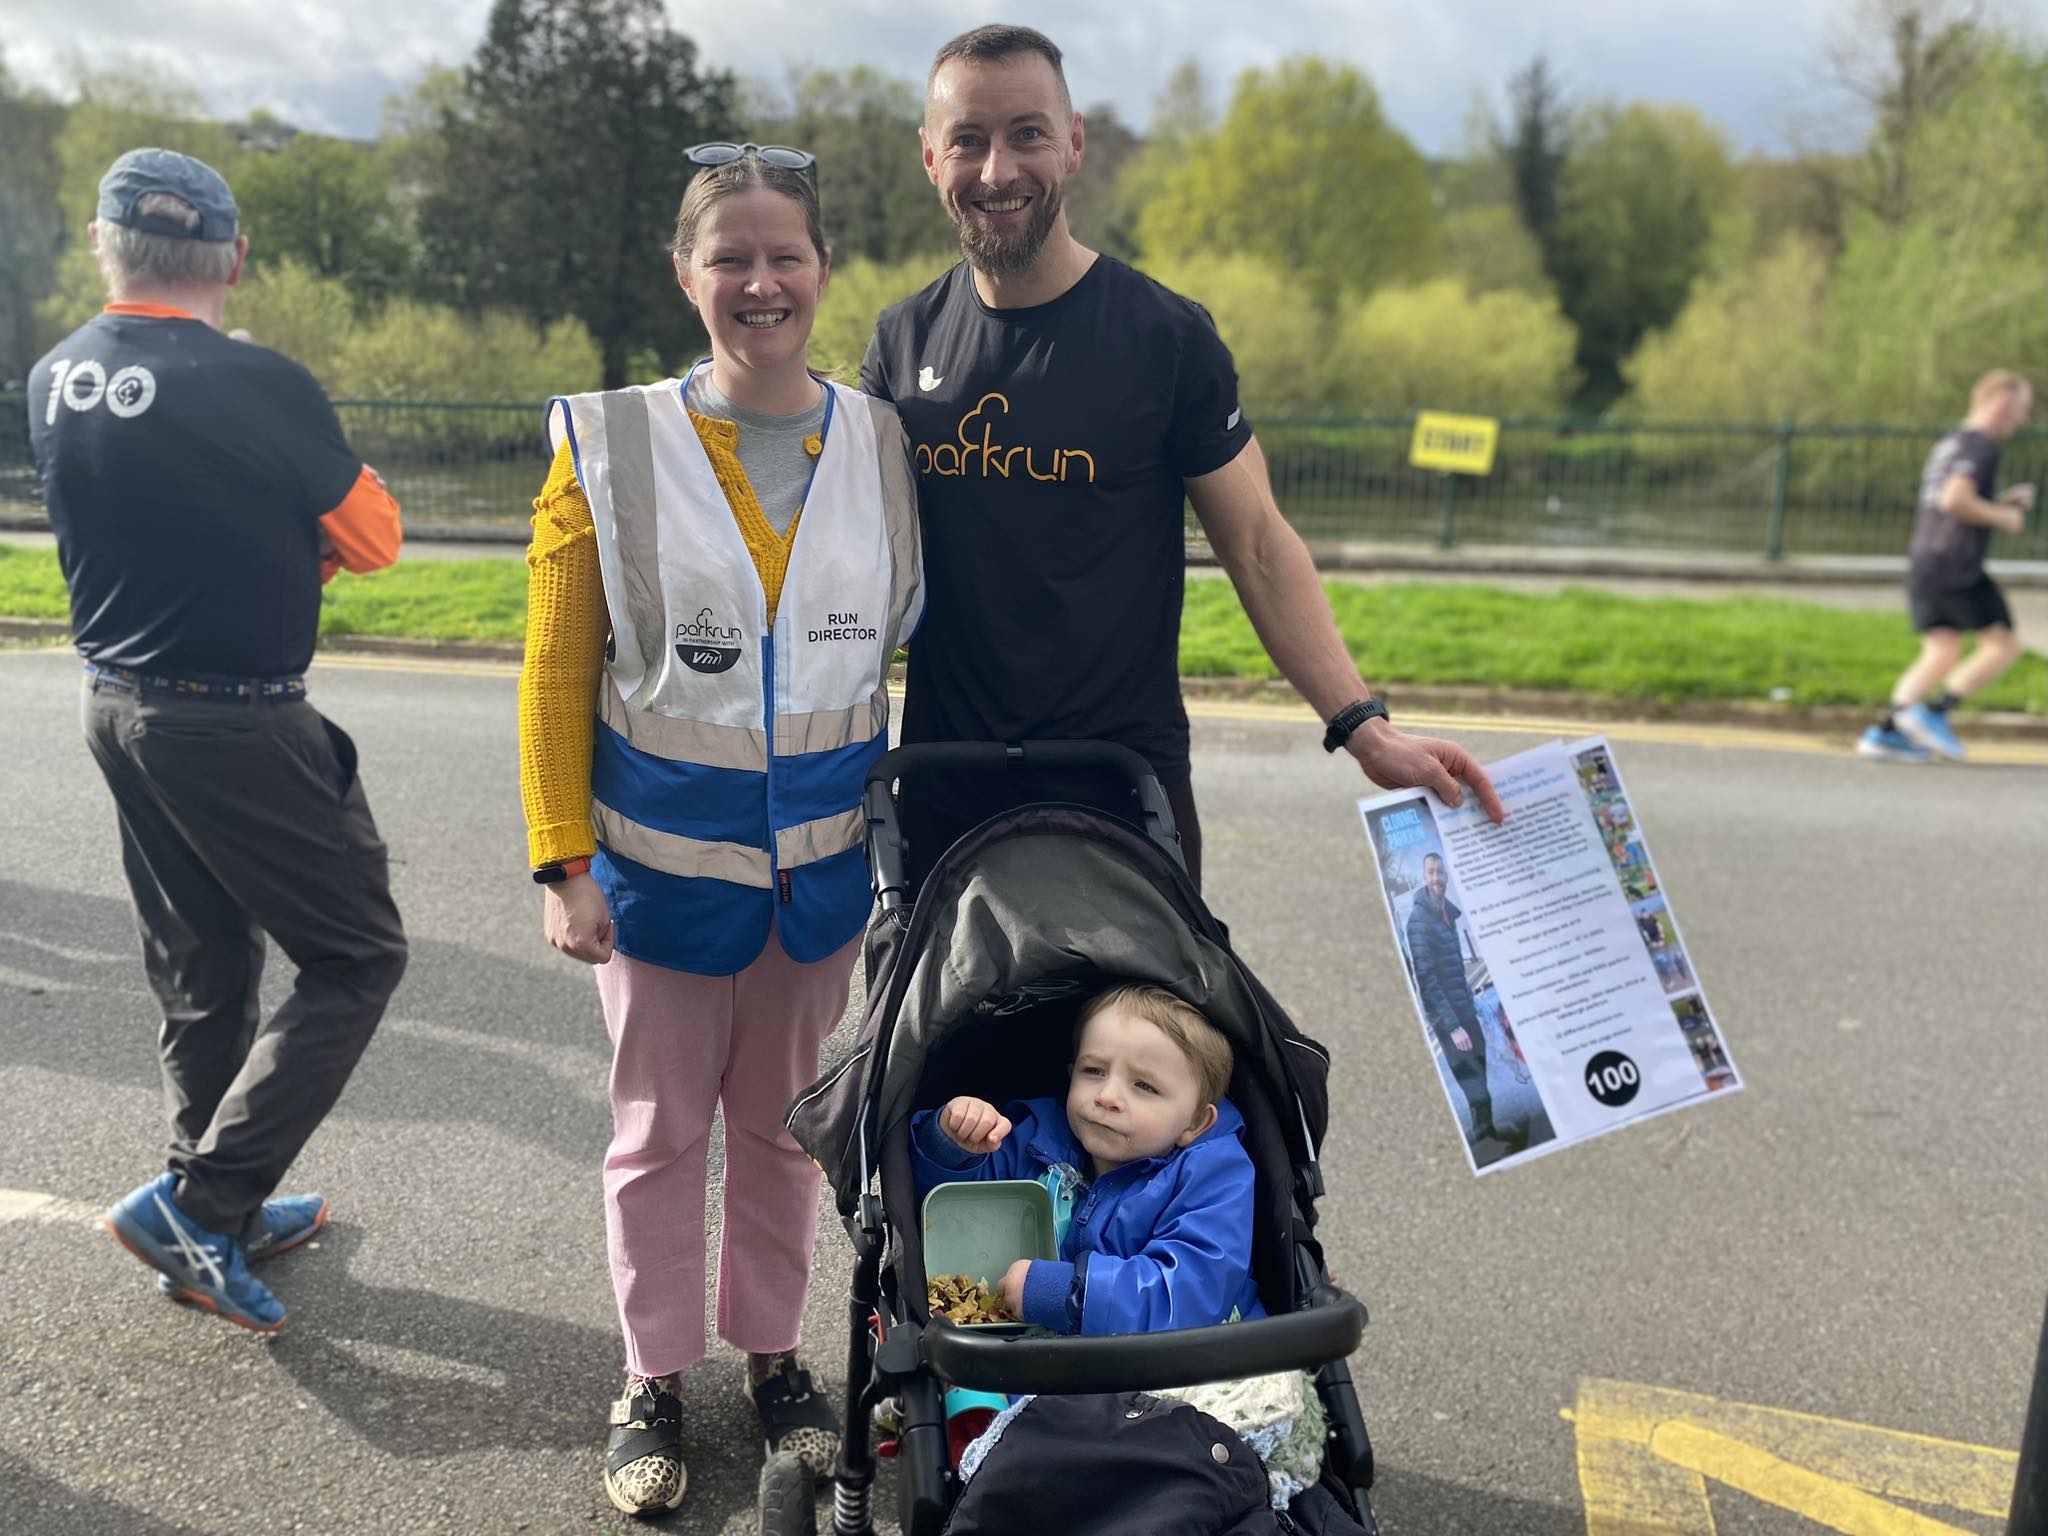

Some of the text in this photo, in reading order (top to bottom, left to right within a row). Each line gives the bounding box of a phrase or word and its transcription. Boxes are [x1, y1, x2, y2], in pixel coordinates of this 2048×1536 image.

[46, 358, 156, 426] 100
[915, 422, 1095, 482] parkrun
[676, 617, 742, 640] parkrun
[827, 613, 858, 625] RUN
[689, 638, 721, 646] PARTNERSHIP
[808, 628, 877, 642] DIRECTOR
[692, 649, 722, 665] Vhi
[1588, 1060, 1638, 1096] 100
